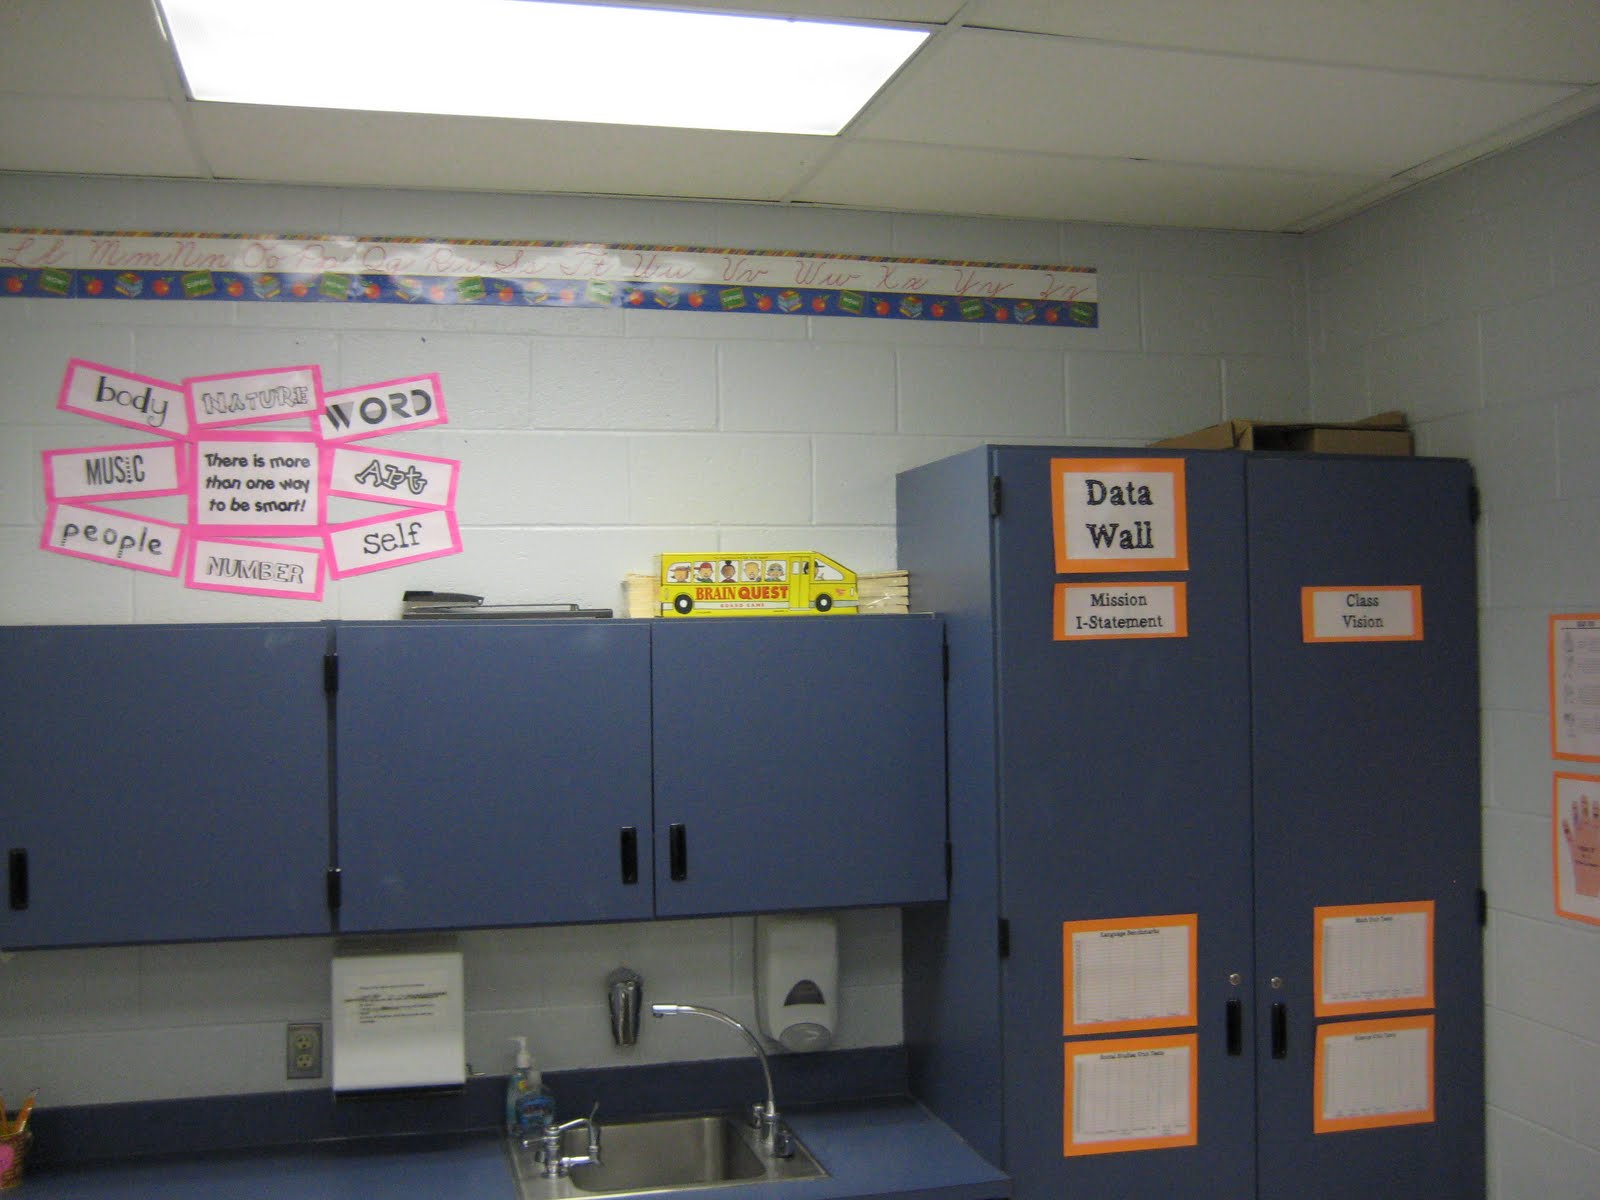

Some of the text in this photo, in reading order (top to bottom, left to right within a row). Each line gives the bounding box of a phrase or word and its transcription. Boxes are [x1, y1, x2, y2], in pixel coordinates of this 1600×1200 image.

[96, 376, 168, 427] body
[202, 385, 309, 415] NATURE
[325, 388, 433, 432] WORD
[86, 455, 145, 486] MUSIC
[204, 453, 311, 469] There is more
[206, 475, 310, 494] than one way
[1085, 479, 1153, 506] Data
[209, 497, 306, 513] to be smart!
[60, 522, 163, 559] people
[1086, 521, 1154, 549] Wall
[206, 555, 304, 584] NUMBER
[695, 586, 788, 601] BRAIN QUEST
[1090, 593, 1148, 607] Mission
[1346, 594, 1379, 607] Class
[1076, 615, 1163, 630] I-Statement
[1342, 615, 1384, 628] Vision
